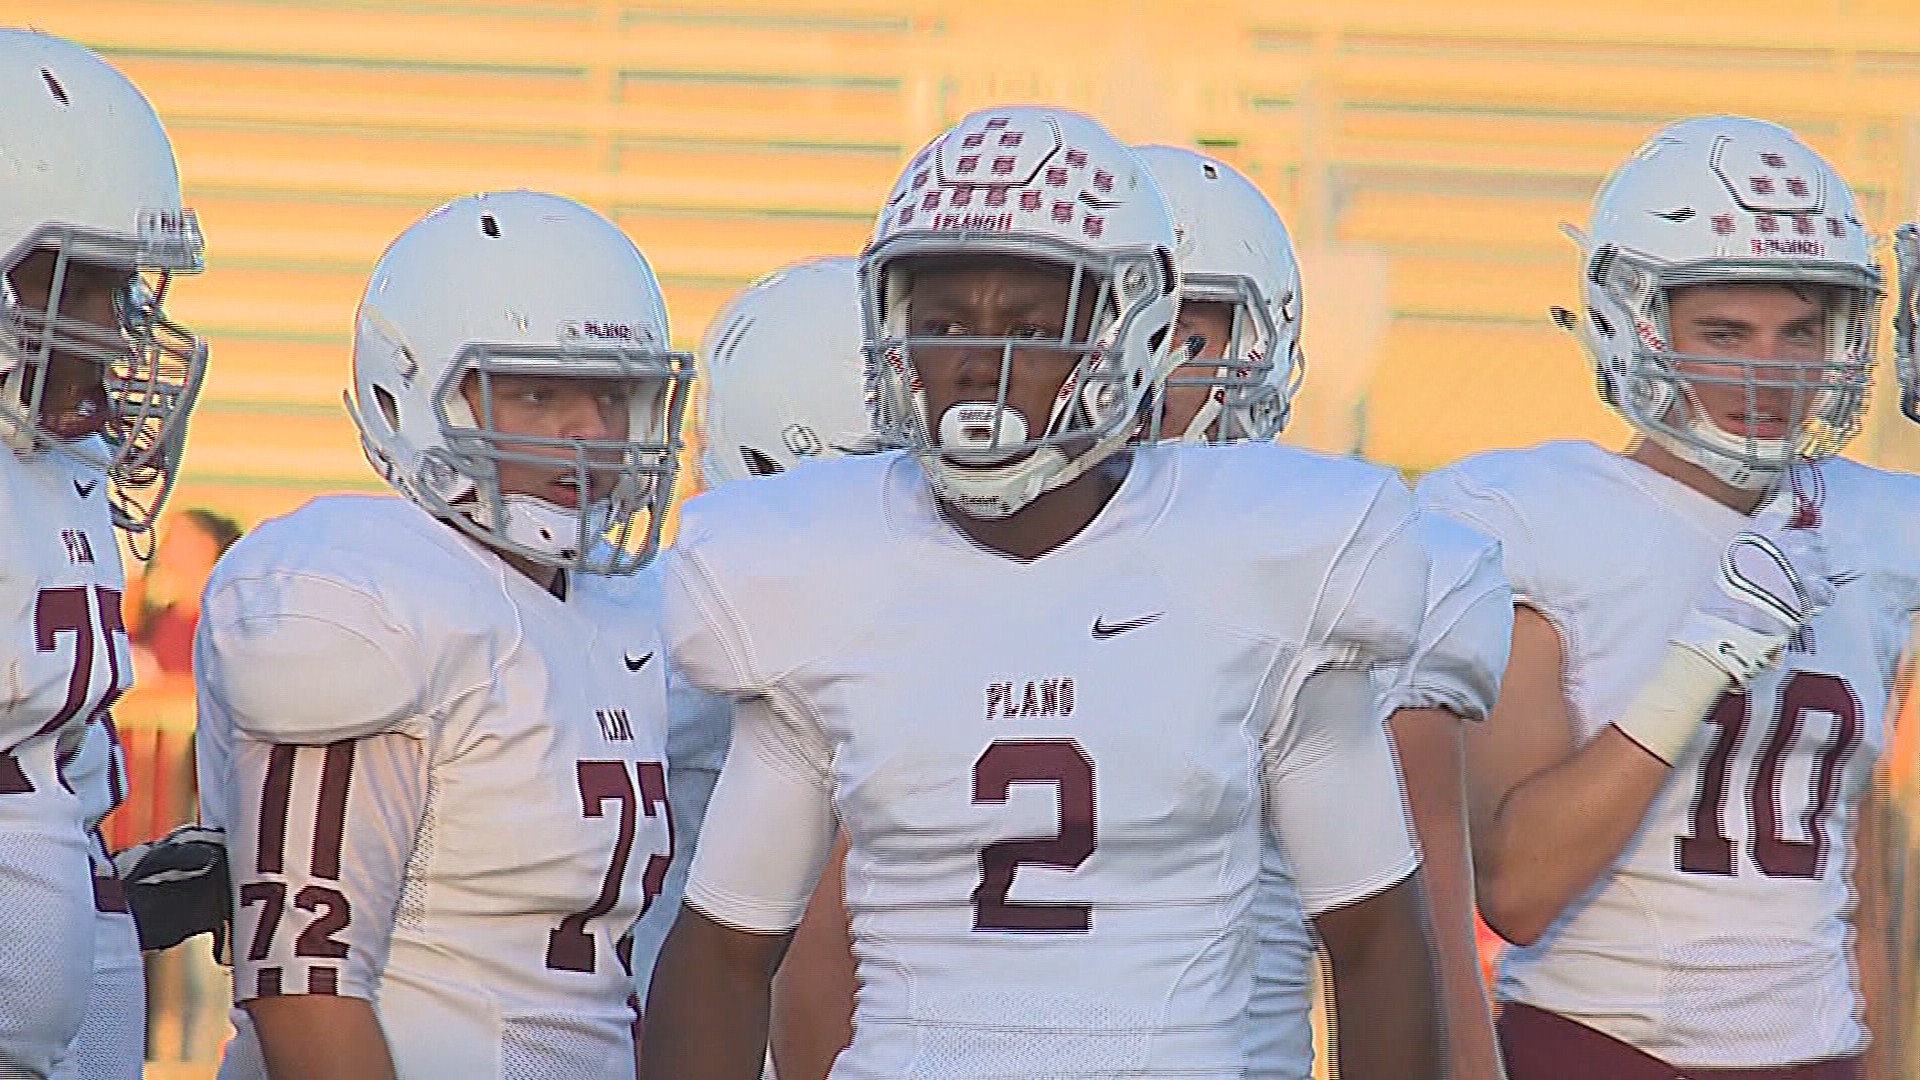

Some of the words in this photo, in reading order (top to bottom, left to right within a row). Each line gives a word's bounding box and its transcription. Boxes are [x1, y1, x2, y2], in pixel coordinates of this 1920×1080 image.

[942, 213, 997, 231] PLANO
[1764, 239, 1817, 256] PLANO
[583, 322, 631, 341] PLANO
[986, 678, 1076, 719] PLANO
[1674, 669, 1865, 880] 10
[970, 739, 1098, 934] 2
[239, 882, 352, 961] 72
